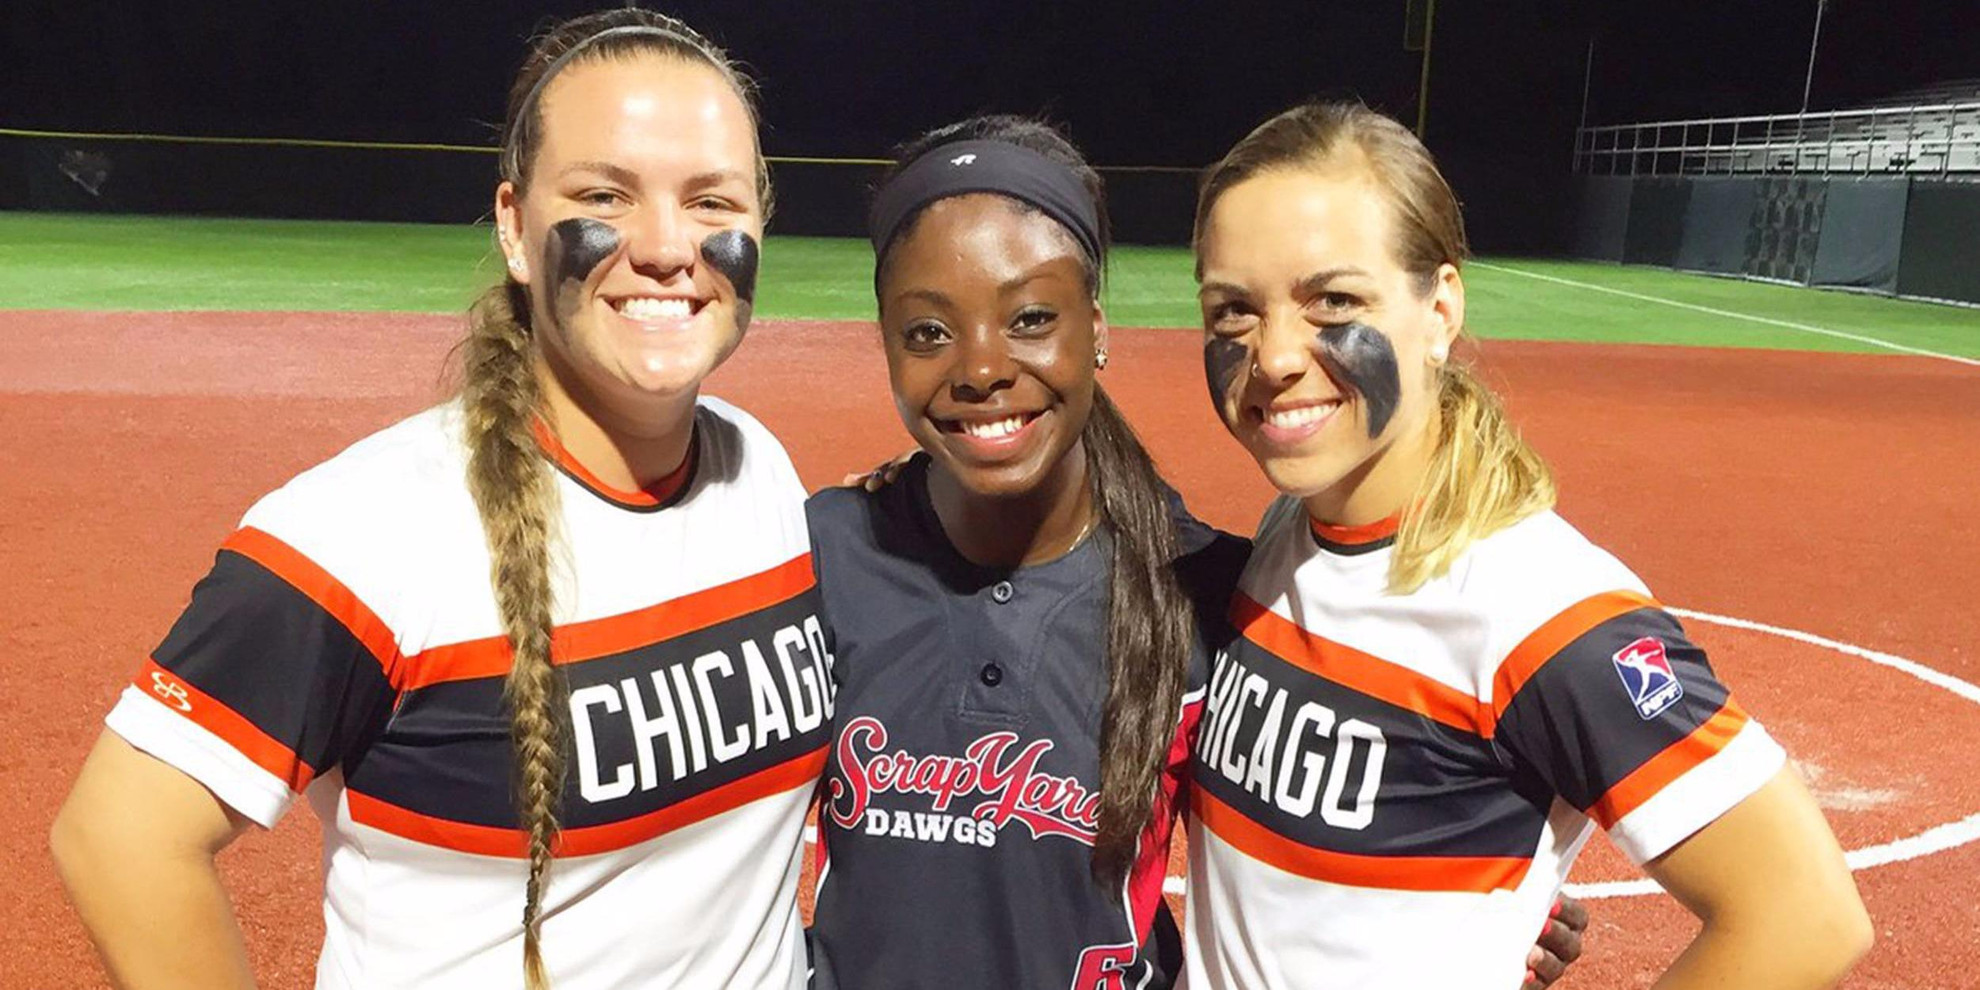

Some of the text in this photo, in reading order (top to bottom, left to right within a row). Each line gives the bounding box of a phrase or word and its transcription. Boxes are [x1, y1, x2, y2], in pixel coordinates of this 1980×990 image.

[569, 613, 837, 803] CHICAGO
[1196, 649, 1388, 831] HICAGO
[1640, 682, 1680, 715] NPF
[865, 808, 997, 848] DAWGS
